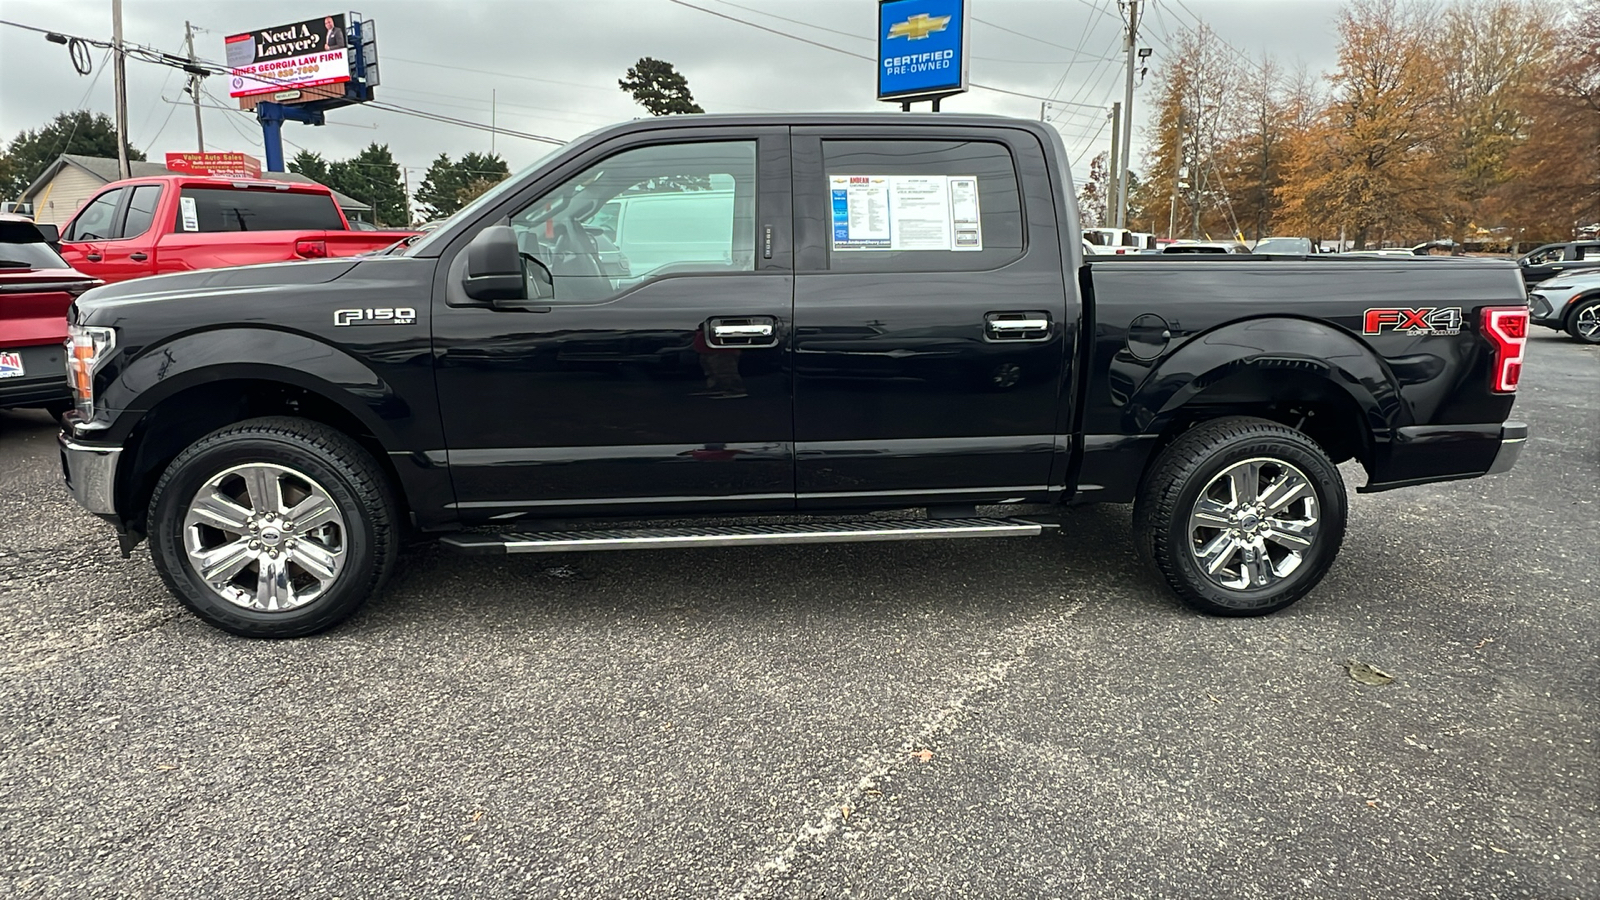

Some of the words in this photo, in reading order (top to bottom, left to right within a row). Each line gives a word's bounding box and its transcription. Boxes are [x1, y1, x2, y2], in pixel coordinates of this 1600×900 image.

[261, 26, 296, 44] Need
[299, 24, 310, 38] A
[257, 34, 320, 57] Lawyer?
[258, 61, 298, 72] GEORGIA
[298, 56, 317, 66] LAW
[319, 51, 342, 63] FIRM
[884, 49, 953, 67] CERTIFIED
[887, 59, 949, 76] PRE-OWNED
[1363, 307, 1462, 335] FX4
